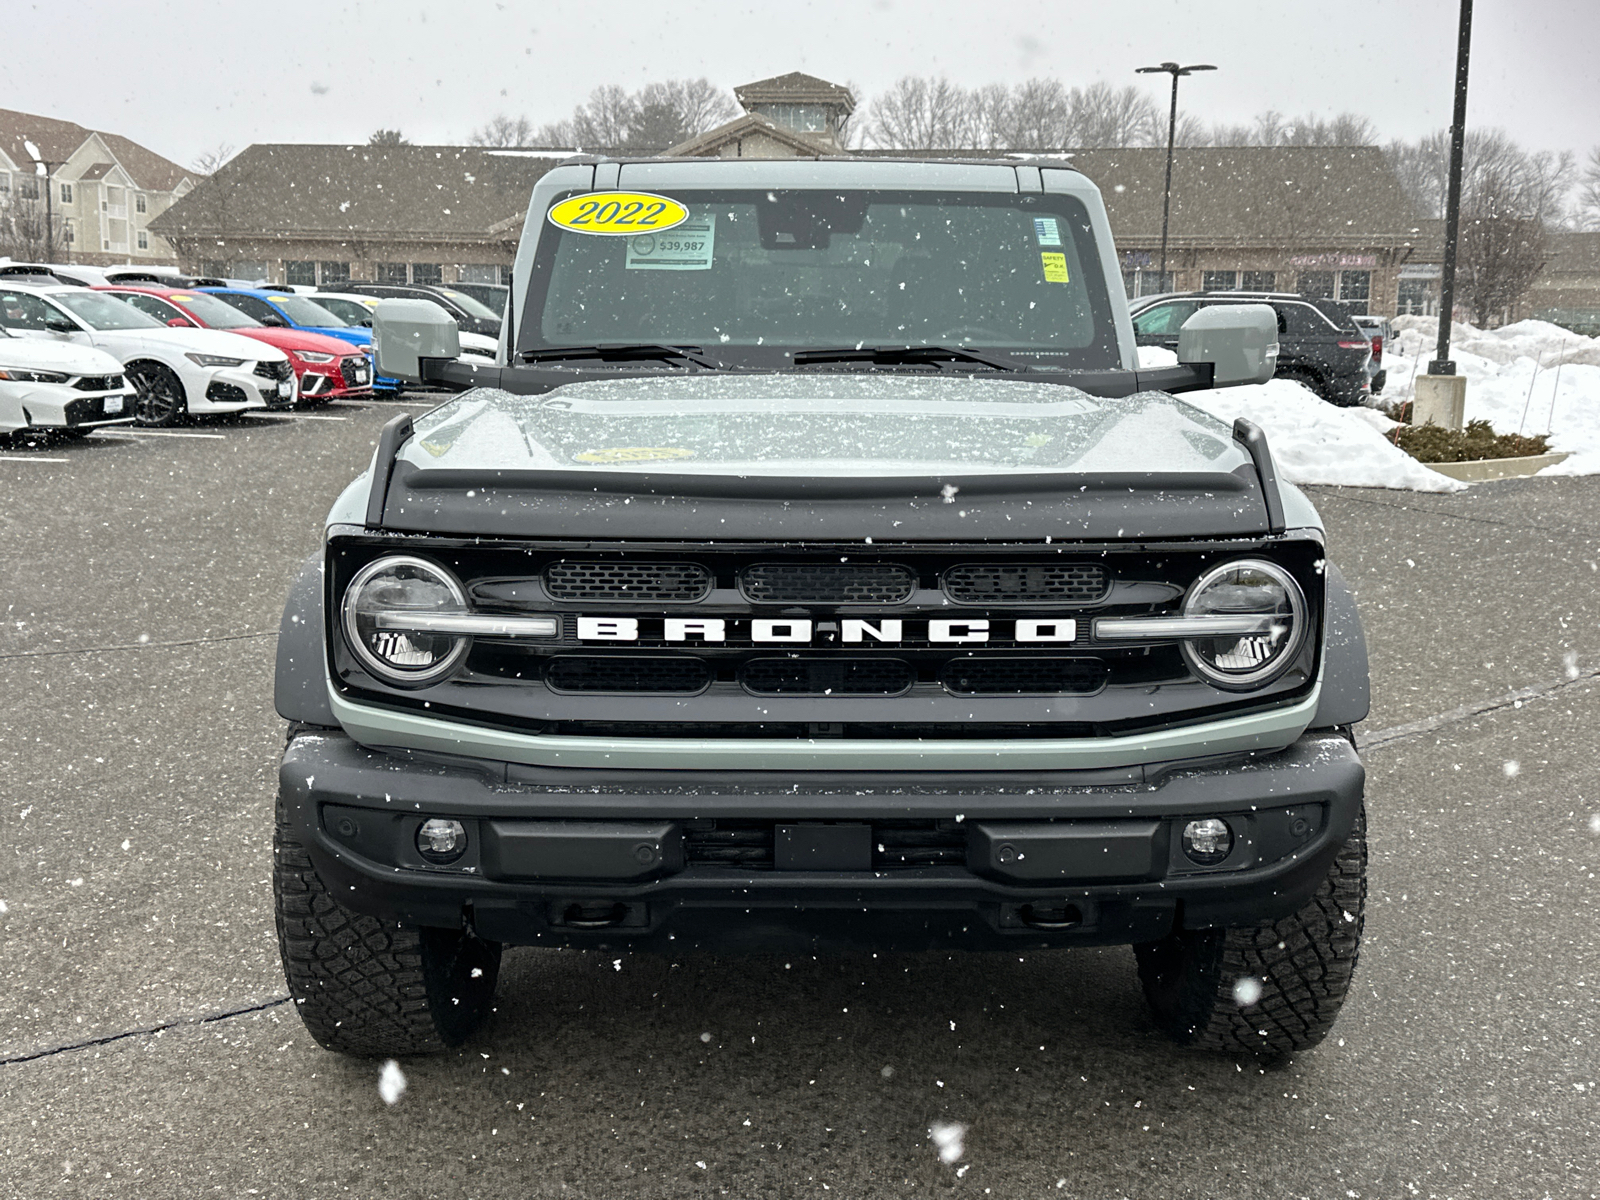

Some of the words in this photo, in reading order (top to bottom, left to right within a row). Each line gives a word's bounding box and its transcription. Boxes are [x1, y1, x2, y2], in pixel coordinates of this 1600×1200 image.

[569, 201, 667, 225] 2022
[659, 241, 705, 252] $39,987
[577, 617, 1077, 643] BRONCO
